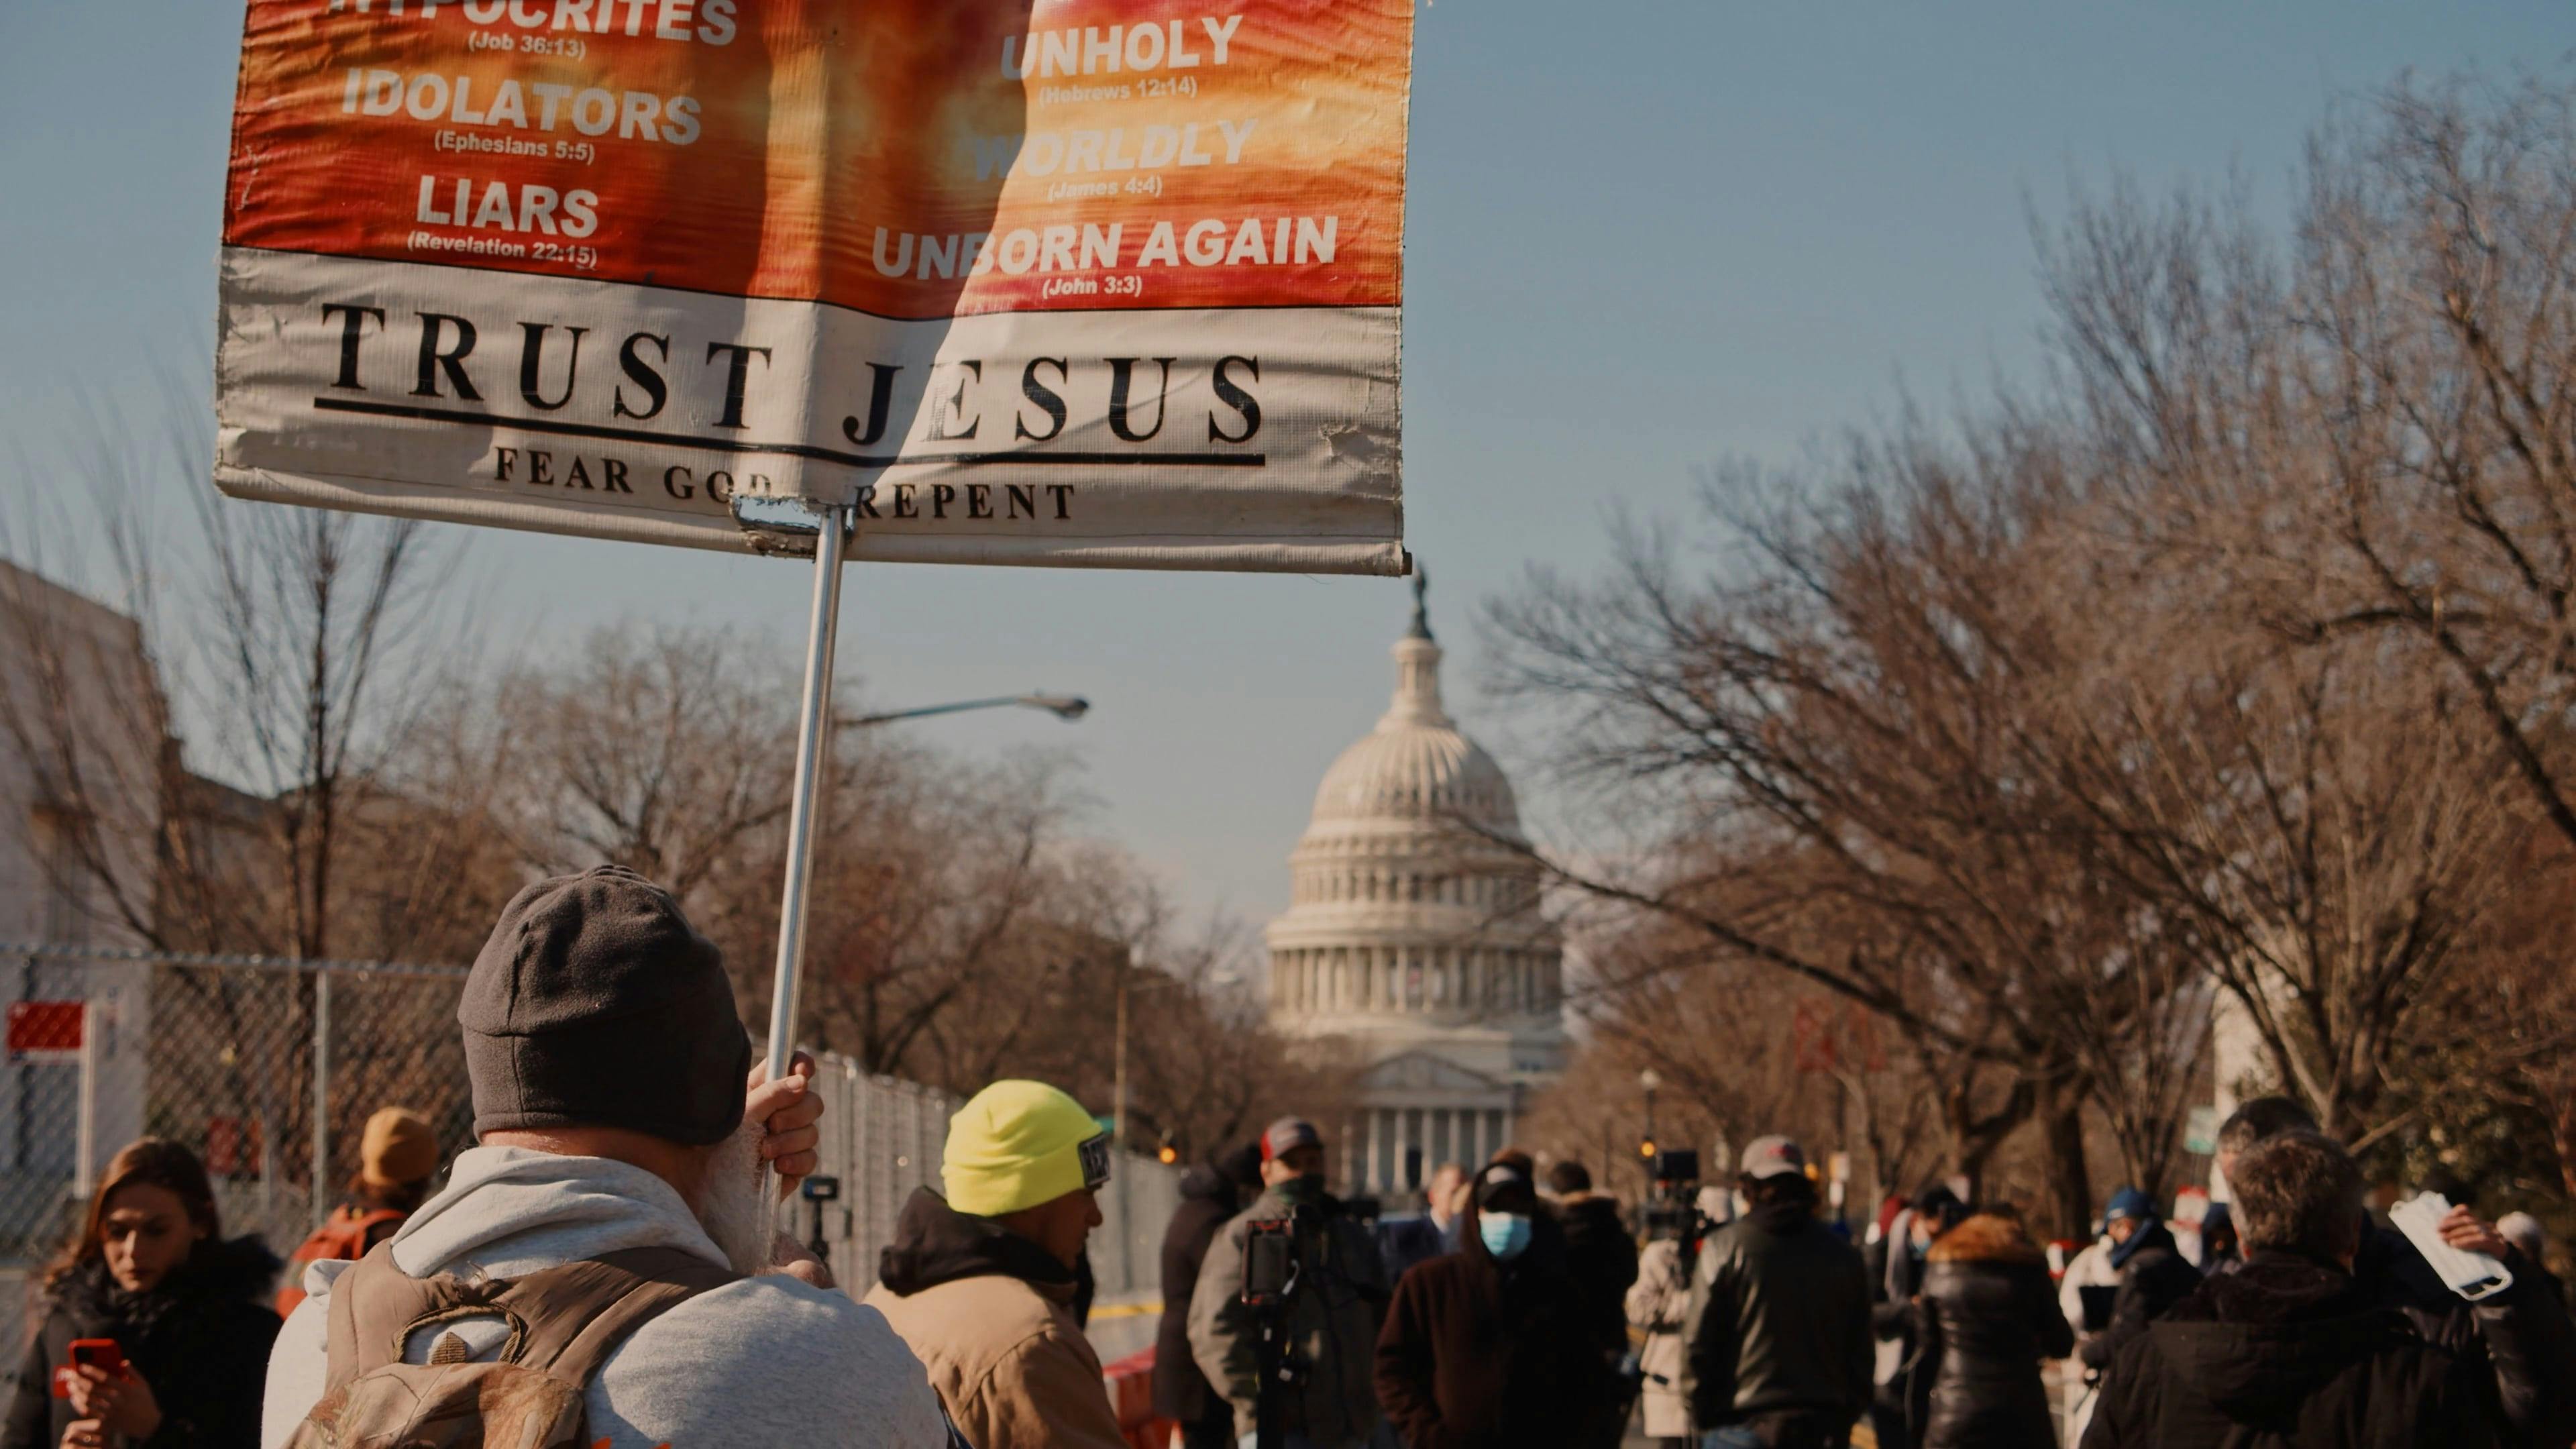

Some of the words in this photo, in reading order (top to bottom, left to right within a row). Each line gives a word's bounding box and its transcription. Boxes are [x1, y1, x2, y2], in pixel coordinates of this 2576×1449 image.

[330, 0, 737, 46] OCRITES
[468, 31, 514, 52] (Job
[520, 36, 587, 62] 36:13)
[1000, 15, 1243, 81] UNHOLY
[341, 67, 702, 145] IDOLATORS
[1038, 82, 1131, 107] (Hebrews
[1136, 75, 1197, 100] 12:14)
[434, 130, 549, 158] (Ephesians
[554, 140, 596, 165] 5:5)
[974, 118, 1258, 182] WORLDLY
[416, 174, 599, 238] LIARS
[1047, 178, 1119, 203] (James
[1124, 174, 1163, 199] 4:4)
[407, 231, 525, 260] (Revelation
[531, 242, 598, 269] 22:15)
[872, 222, 1123, 282] UNBORN
[1139, 215, 1339, 268] AGAIN
[1042, 278, 1099, 300] (John
[1102, 275, 1143, 297] 3:3)
[322, 303, 773, 431] TRUST
[841, 355, 1262, 445] JESUS
[494, 447, 634, 494] FEAR
[854, 483, 1075, 519] REPENT
